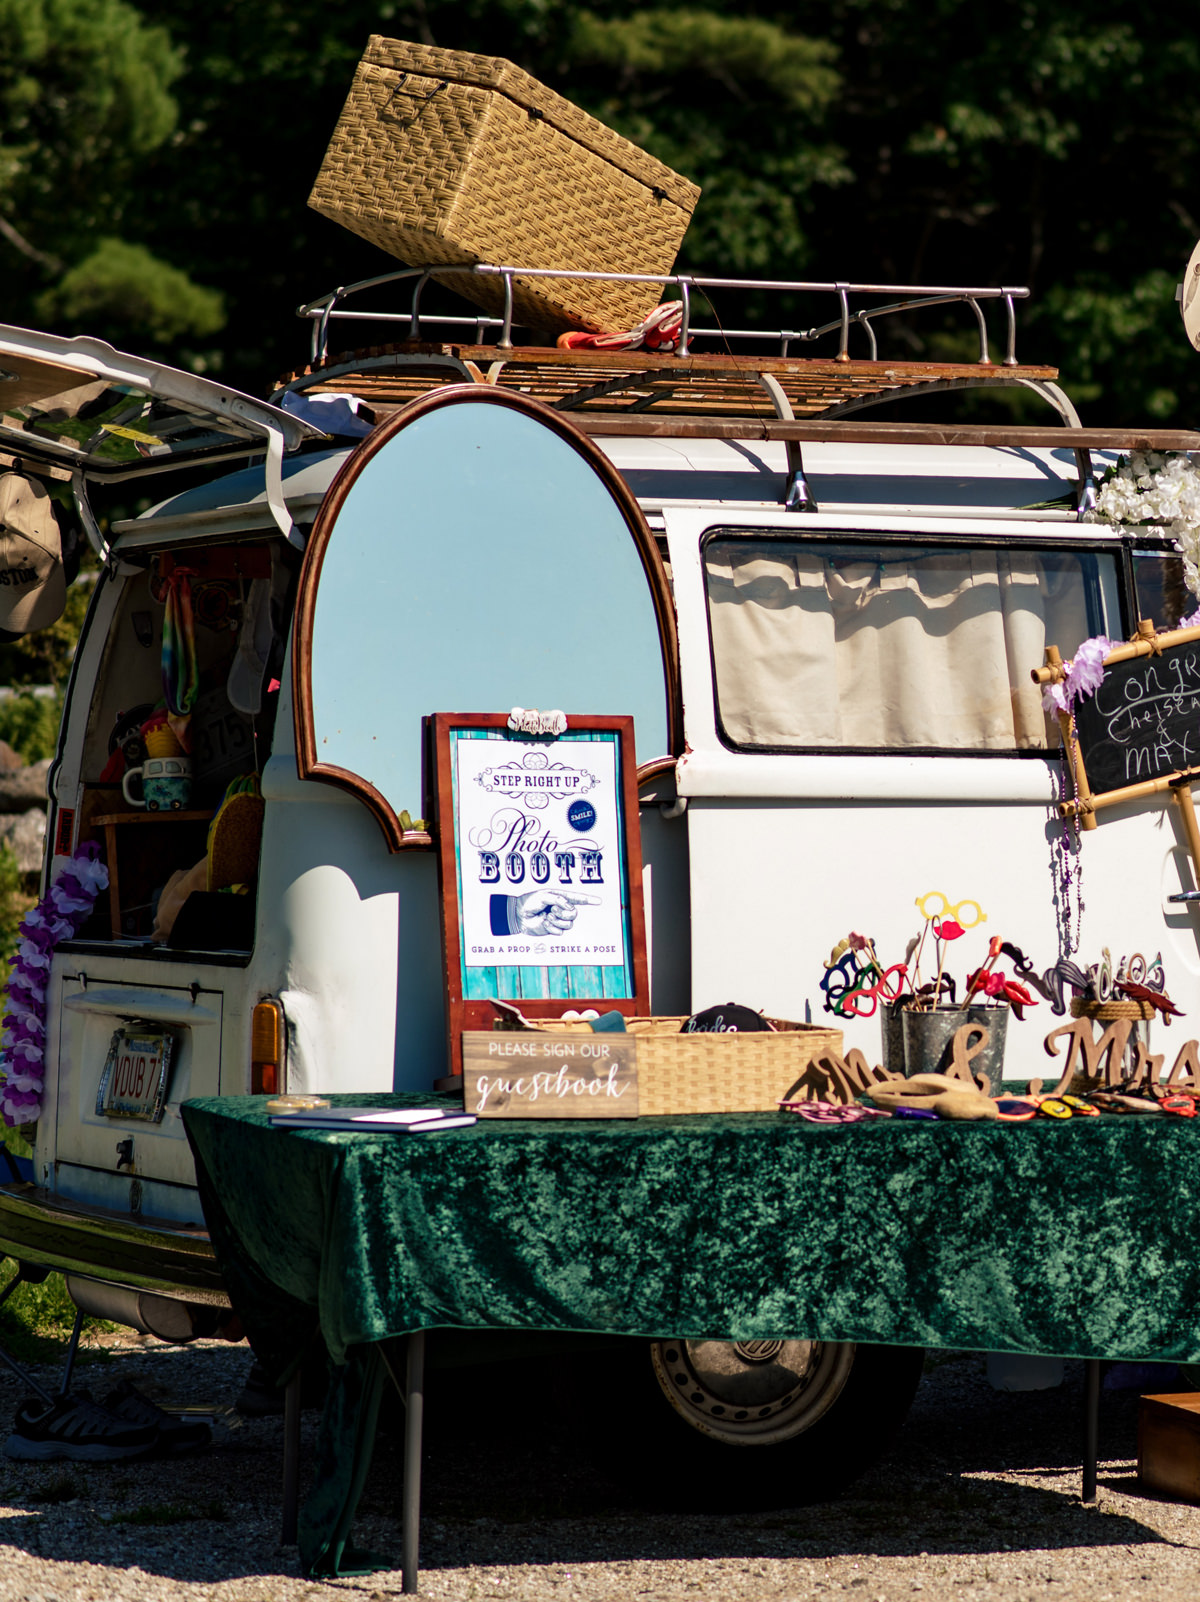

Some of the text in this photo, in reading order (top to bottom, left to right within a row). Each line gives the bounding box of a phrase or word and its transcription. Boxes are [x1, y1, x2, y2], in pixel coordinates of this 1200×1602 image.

[493, 774, 580, 788] STEP RIGHT UP
[469, 808, 604, 853] Photo
[478, 851, 604, 884] BOOTH
[489, 1042, 610, 1057] PLEASE SIGN OUR
[945, 1023, 990, 1097] &
[113, 1056, 146, 1098] VDUB
[476, 1063, 630, 1112] guestbook
